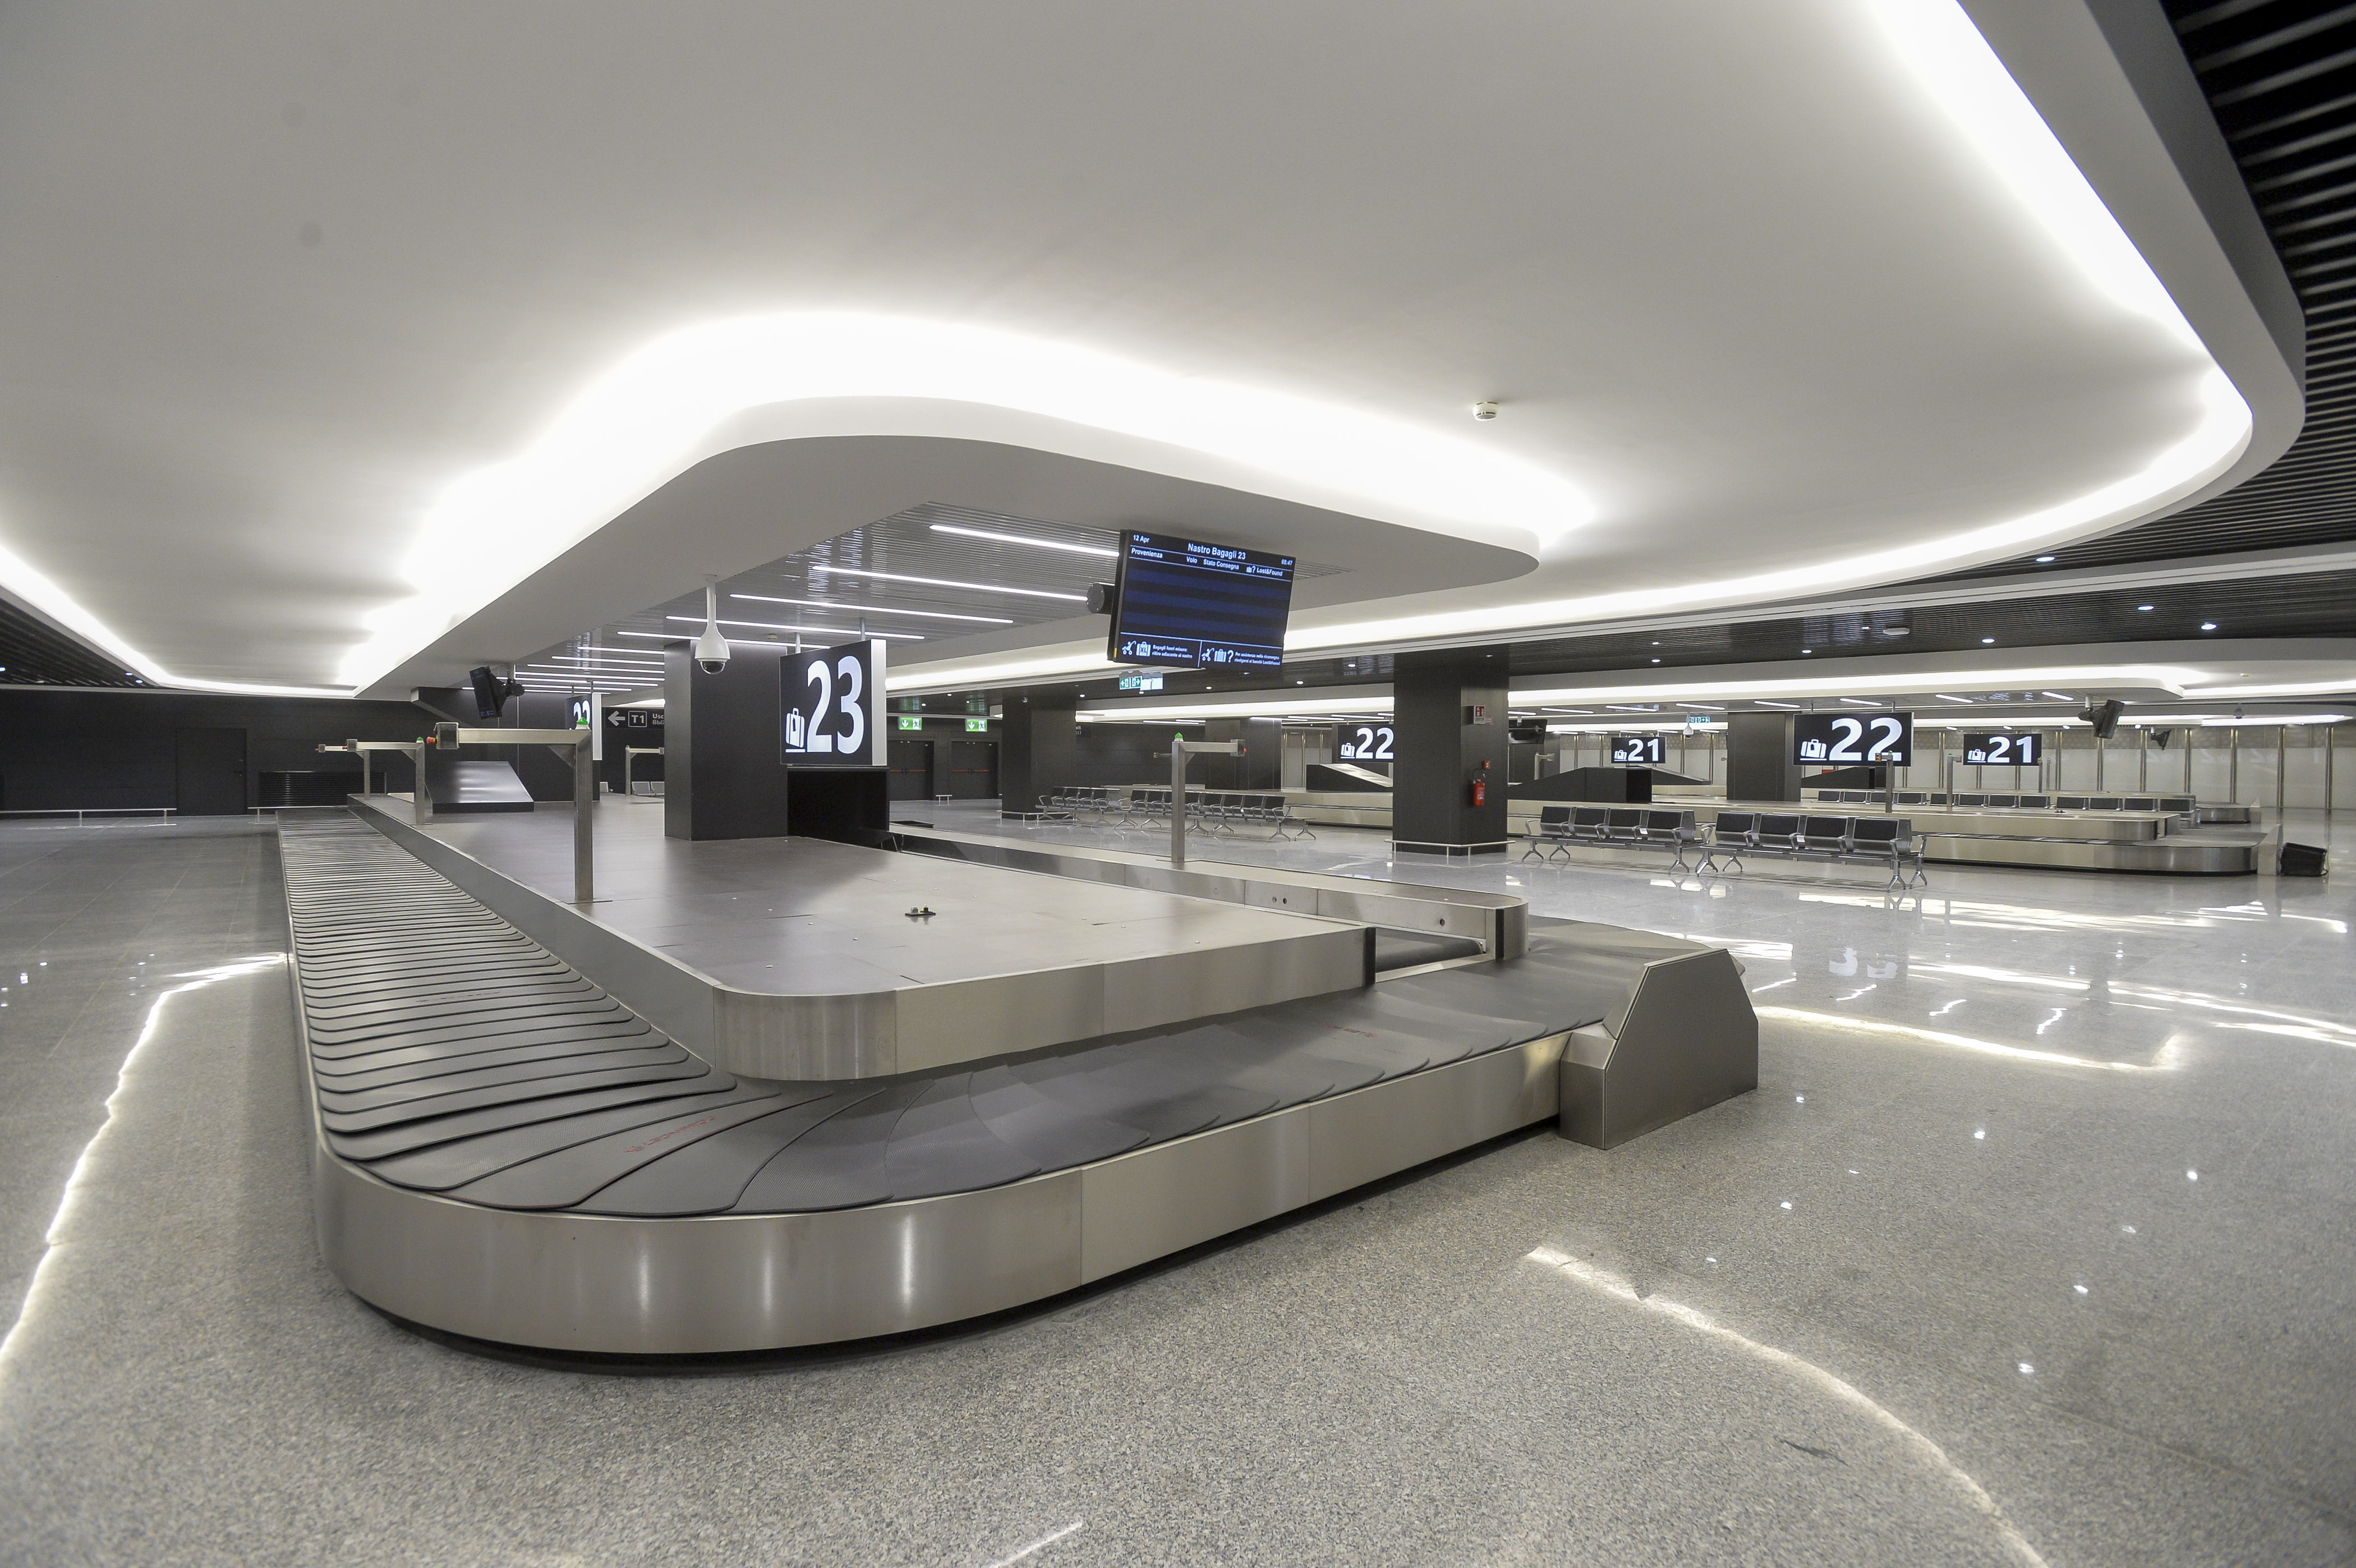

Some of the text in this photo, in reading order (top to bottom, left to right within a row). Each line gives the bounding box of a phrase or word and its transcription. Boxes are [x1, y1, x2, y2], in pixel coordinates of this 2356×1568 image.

[1131, 548, 1163, 558] Provenienza
[1188, 543, 1246, 560] Nastro Bagagli 23
[1216, 562, 1239, 571] Consegna
[1257, 567, 1283, 577] Lost&Found
[807, 655, 864, 755] 23
[631, 715, 645, 724] T1
[1355, 727, 1394, 759] 22
[1628, 738, 1659, 761] 21
[1829, 717, 1902, 761] 22
[1987, 736, 2032, 763] 21
